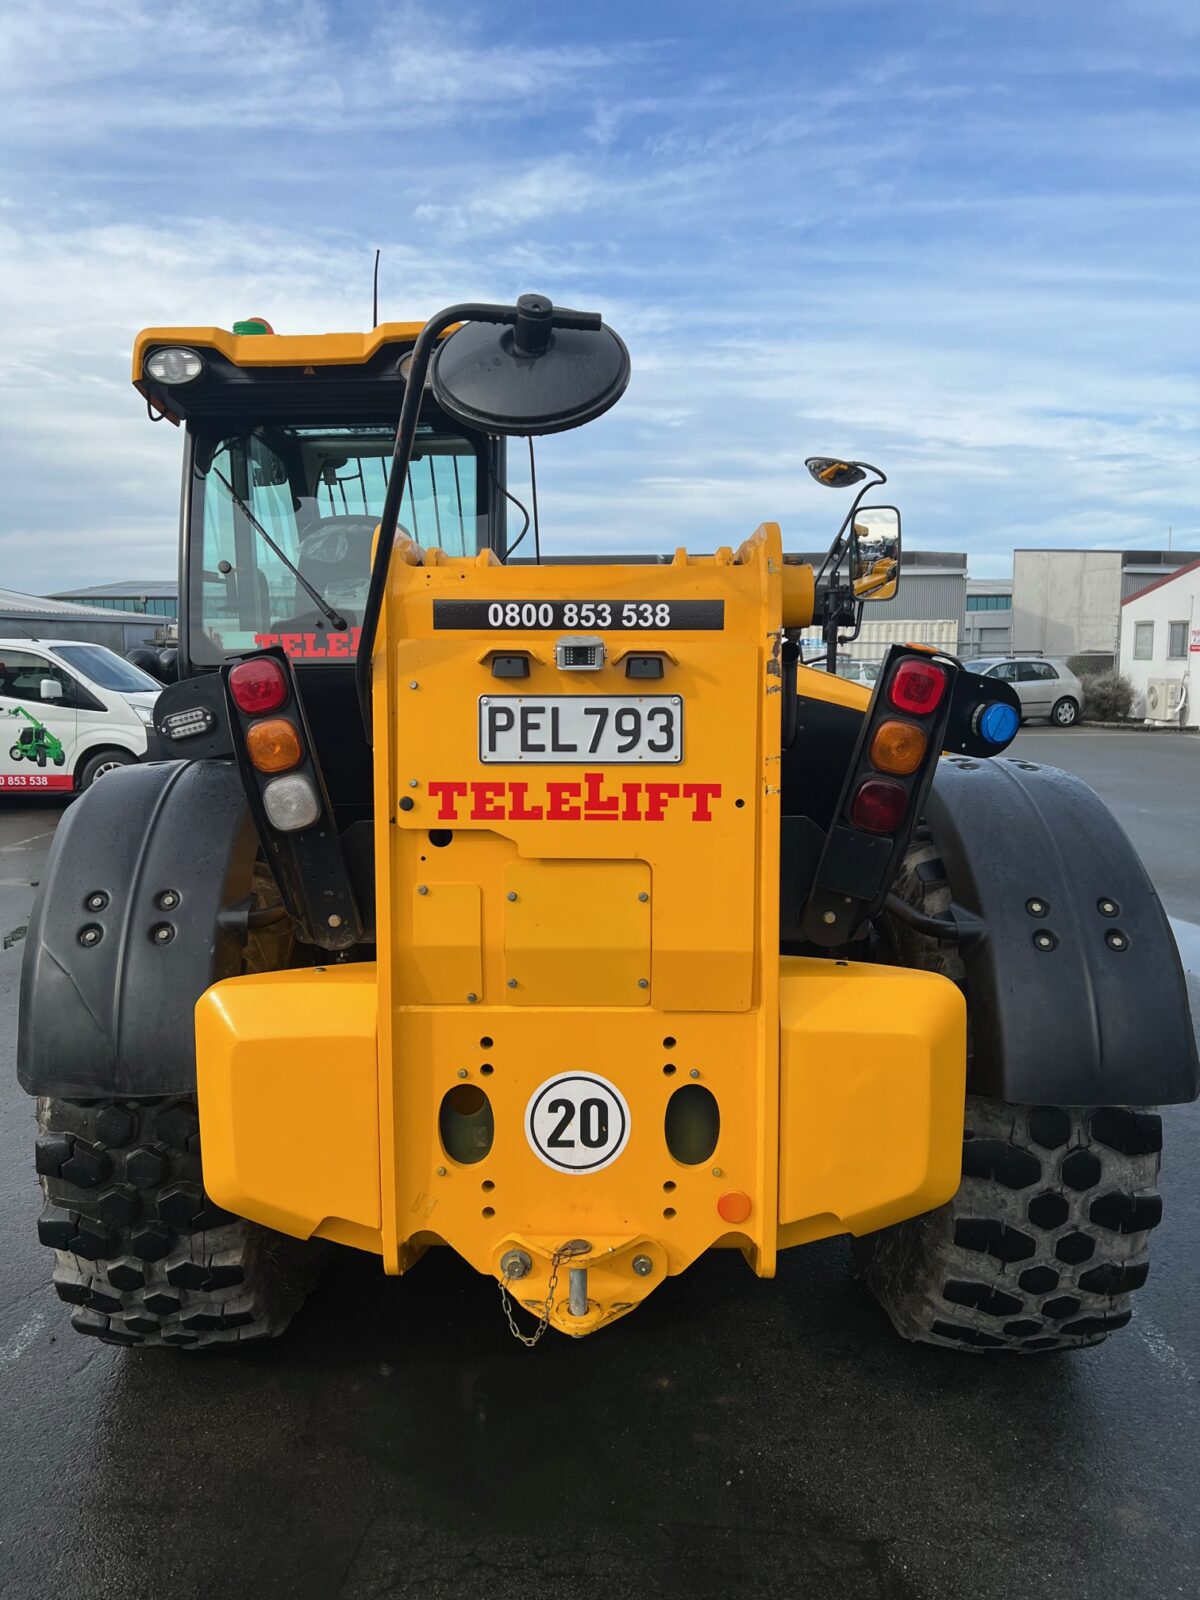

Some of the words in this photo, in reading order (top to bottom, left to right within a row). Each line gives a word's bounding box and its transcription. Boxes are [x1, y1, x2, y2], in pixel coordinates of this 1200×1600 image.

[488, 603, 553, 627] 0800
[563, 604, 612, 627] 853
[621, 604, 671, 627] 538
[488, 706, 674, 753] PEL793
[7, 776, 27, 786] 853
[29, 776, 48, 786] 538
[428, 773, 722, 821] TELELIFT
[547, 1098, 608, 1148] 20
